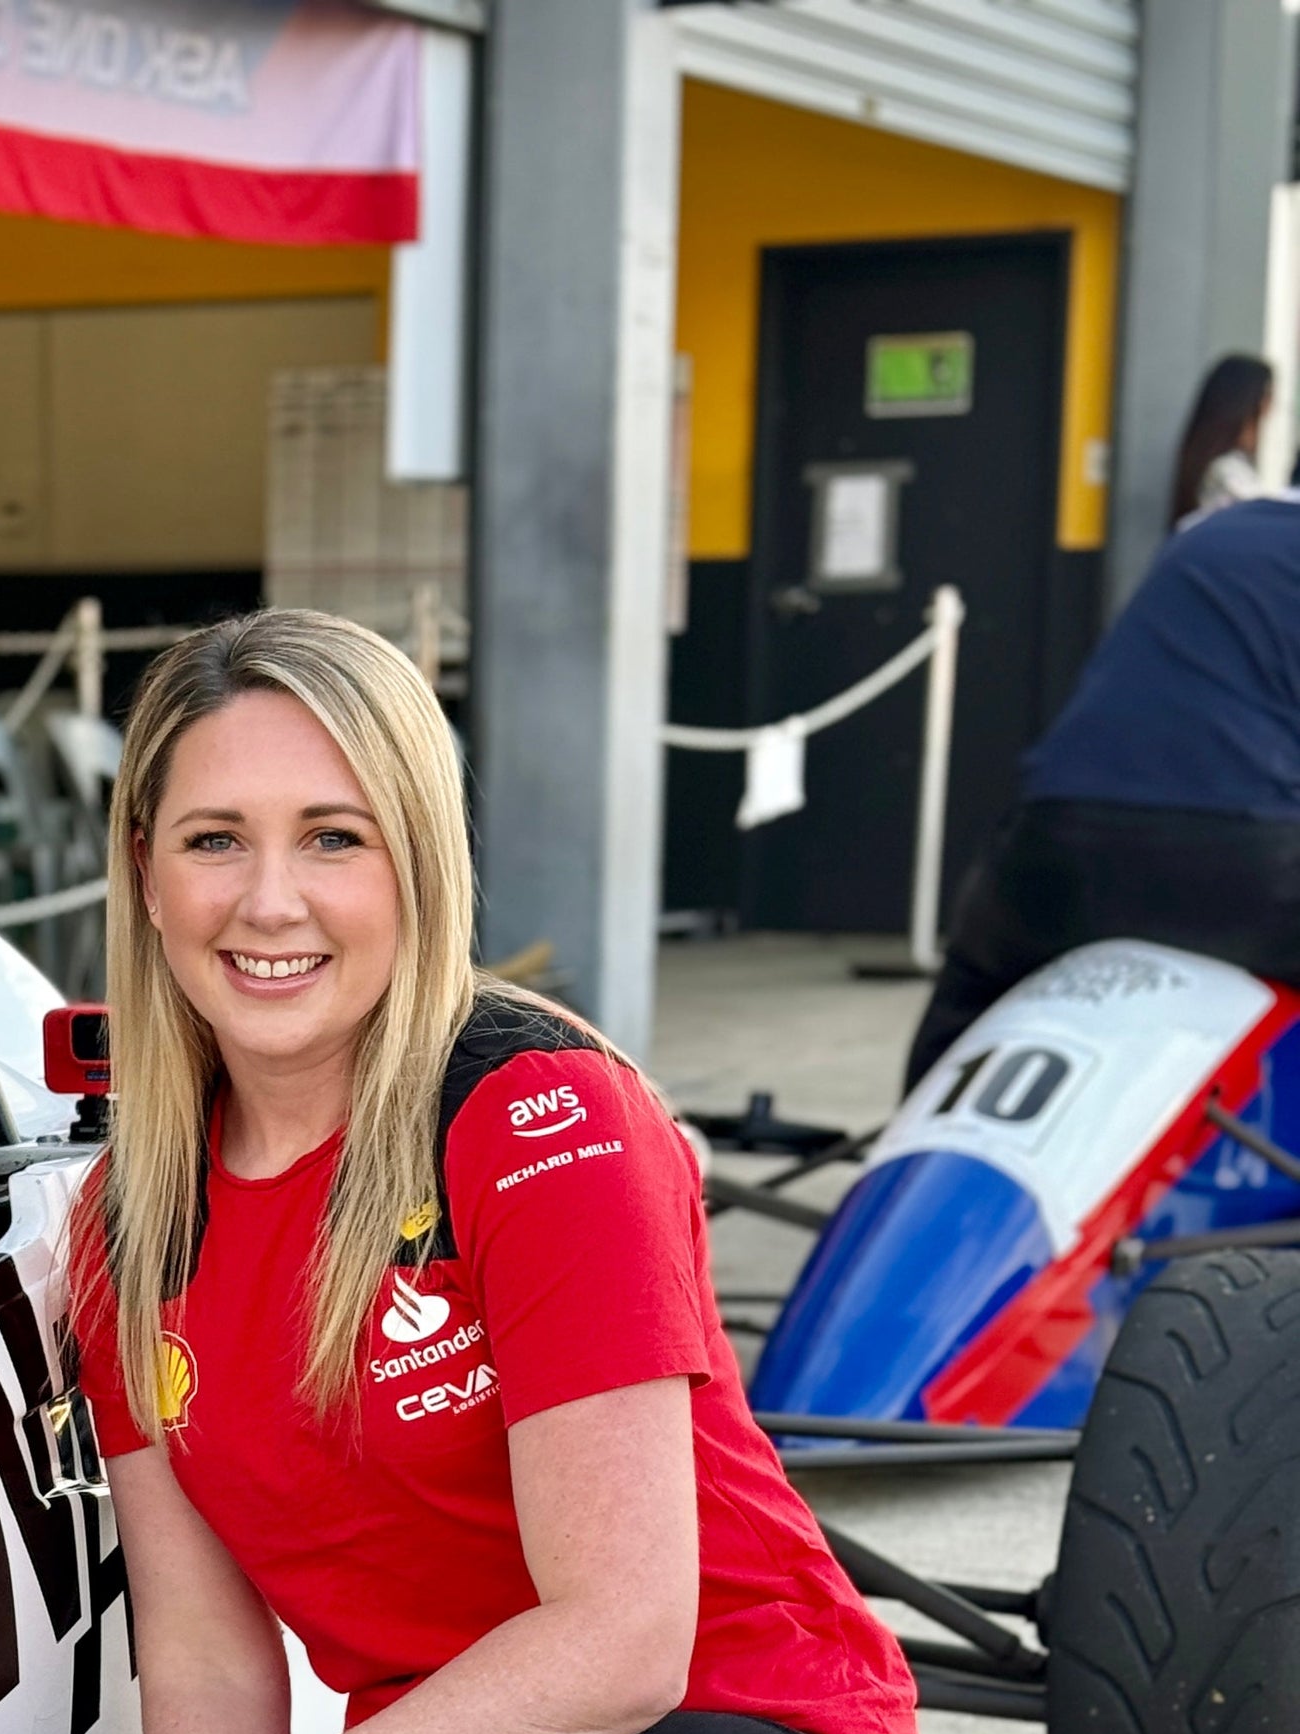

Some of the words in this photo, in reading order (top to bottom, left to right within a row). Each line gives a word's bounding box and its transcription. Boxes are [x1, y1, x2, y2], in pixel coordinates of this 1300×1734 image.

[506, 1084, 580, 1127] aws
[933, 1046, 1071, 1122] 10
[495, 1151, 574, 1193] RICHARD
[576, 1140, 625, 1160] MILLE
[369, 1319, 486, 1383] Santander
